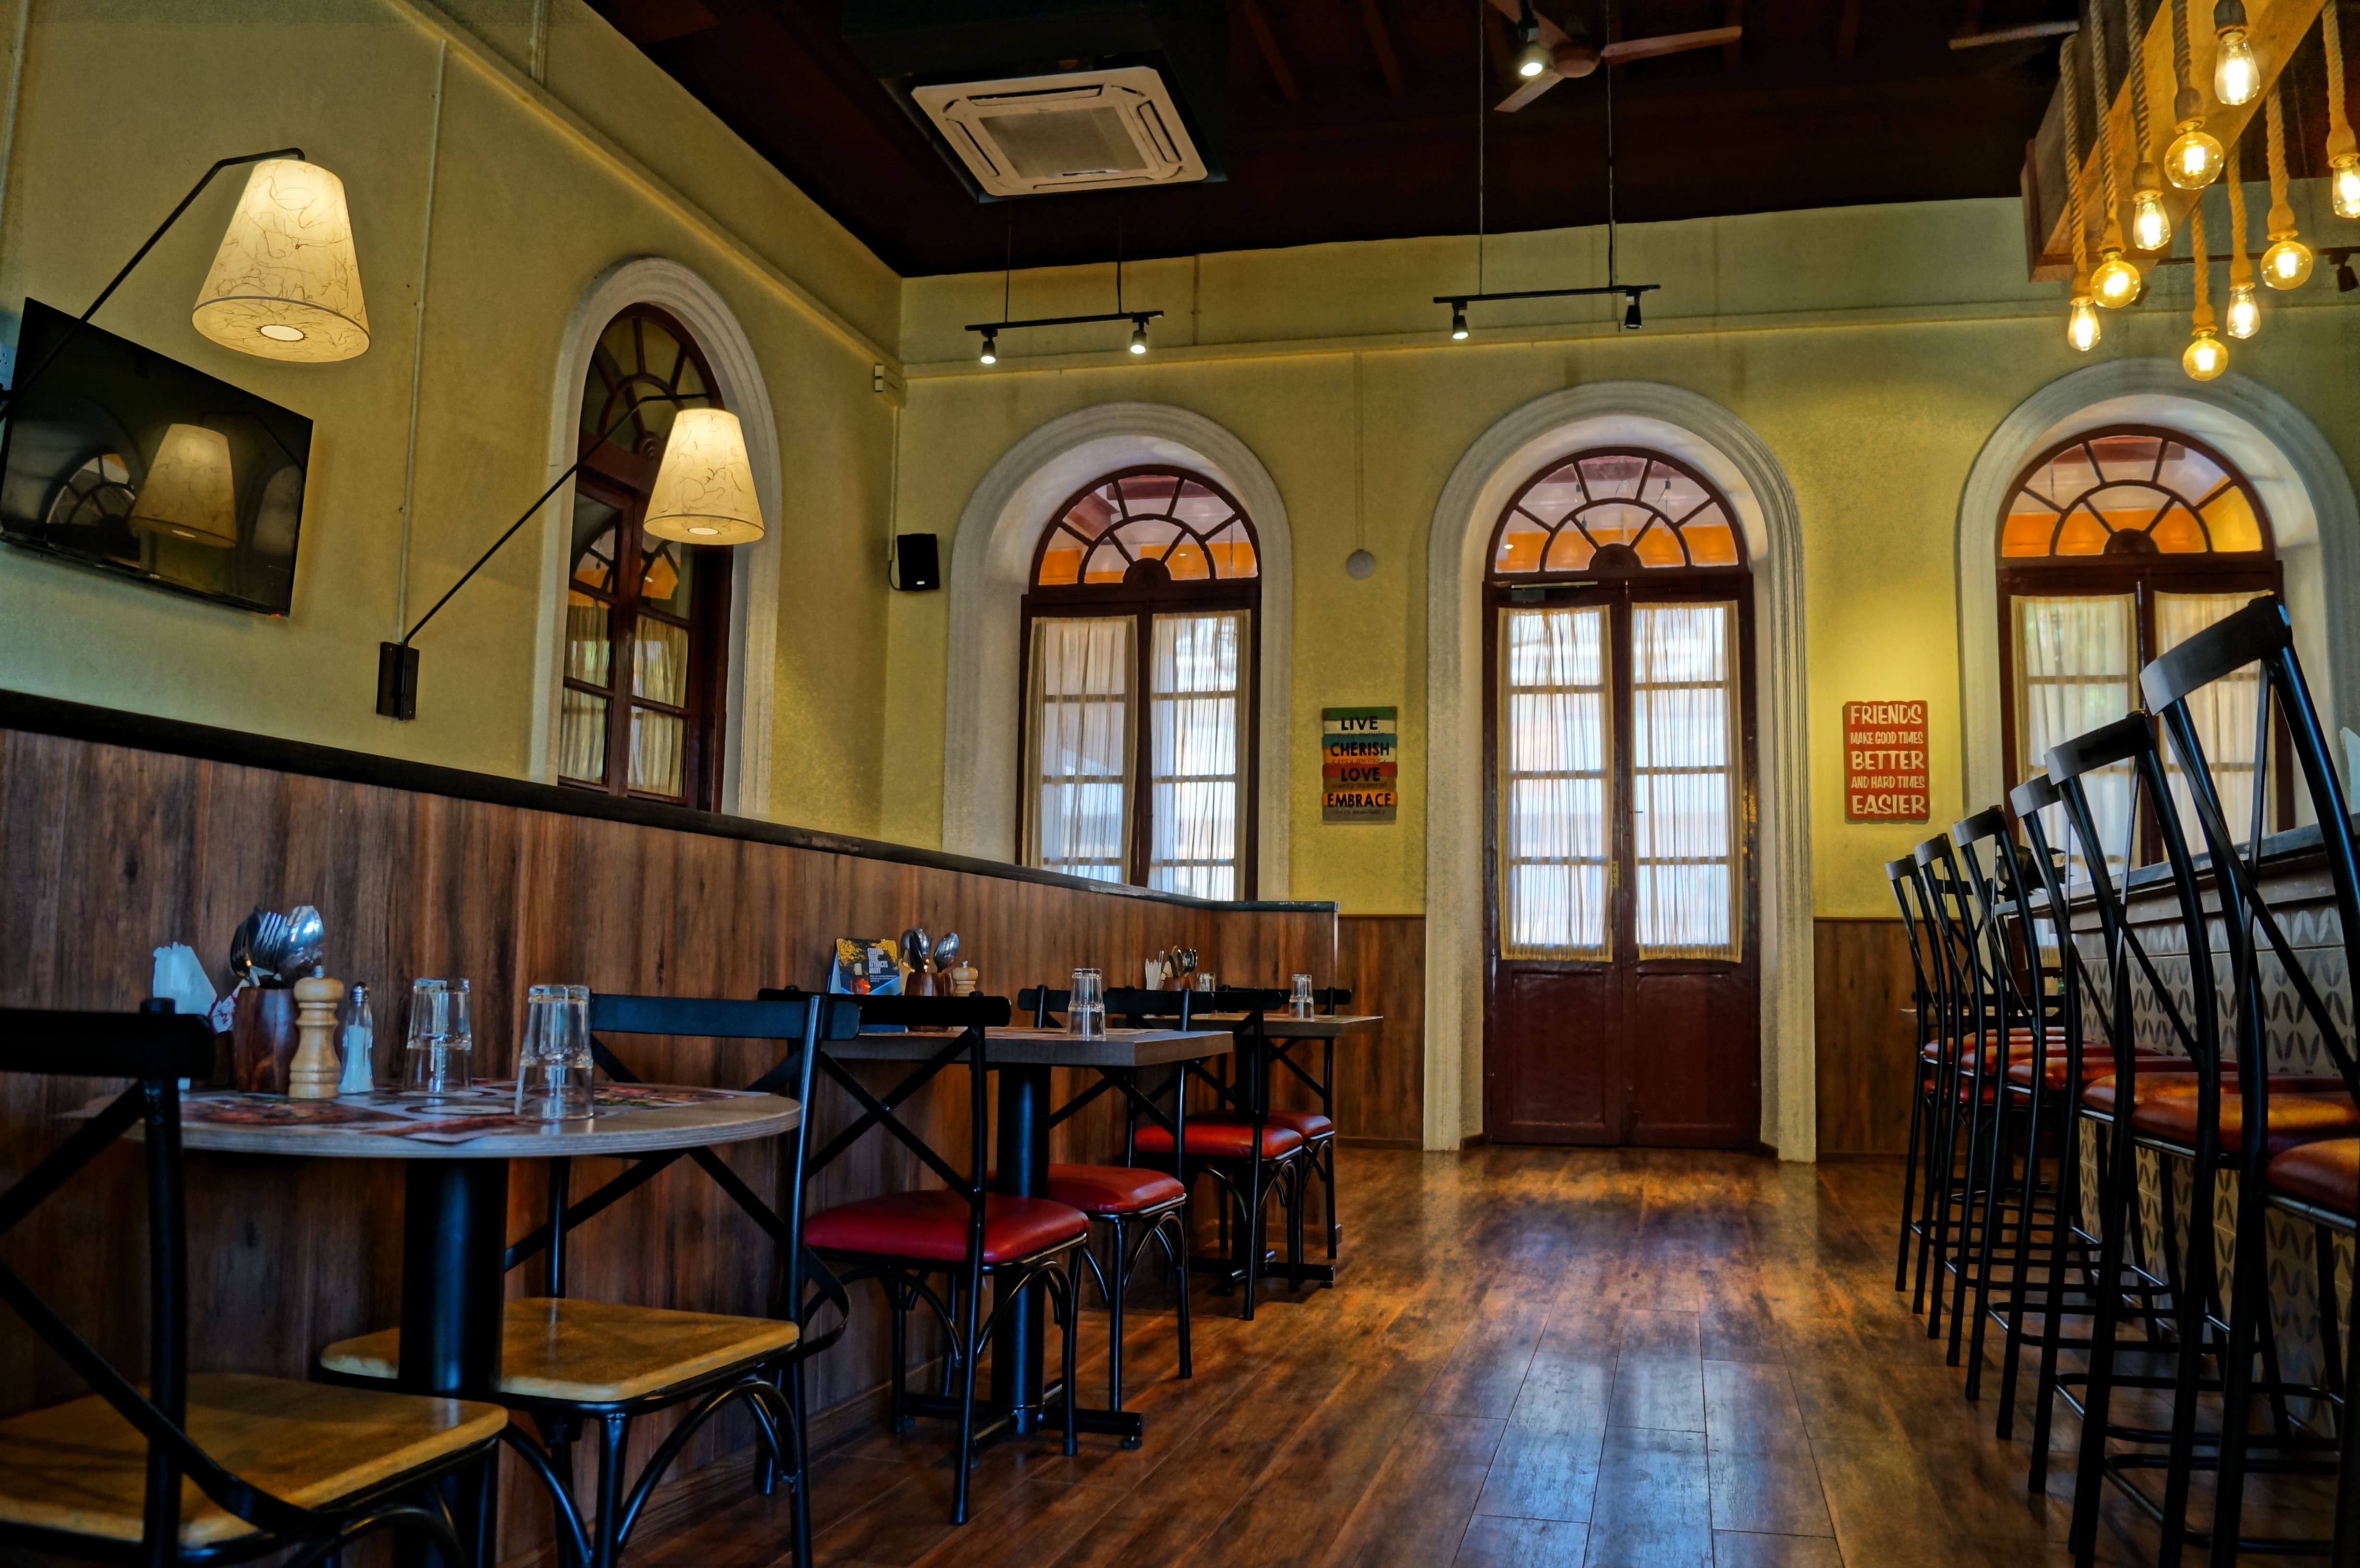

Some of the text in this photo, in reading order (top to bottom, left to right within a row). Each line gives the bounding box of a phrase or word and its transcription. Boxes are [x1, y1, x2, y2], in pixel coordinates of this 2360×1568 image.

[1850, 704, 1922, 725] FRIENDS
[1341, 716, 1378, 731] LIVE
[1850, 731, 1924, 745] MAKE GOOD TIMES
[1330, 742, 1389, 757] CHERISH
[1851, 750, 1925, 770] BETTER
[1341, 767, 1380, 782] LOVE
[1851, 775, 1925, 789] AND HARD TIMES
[1328, 793, 1391, 808] EMBRACE
[1852, 794, 1926, 815] EASIER
